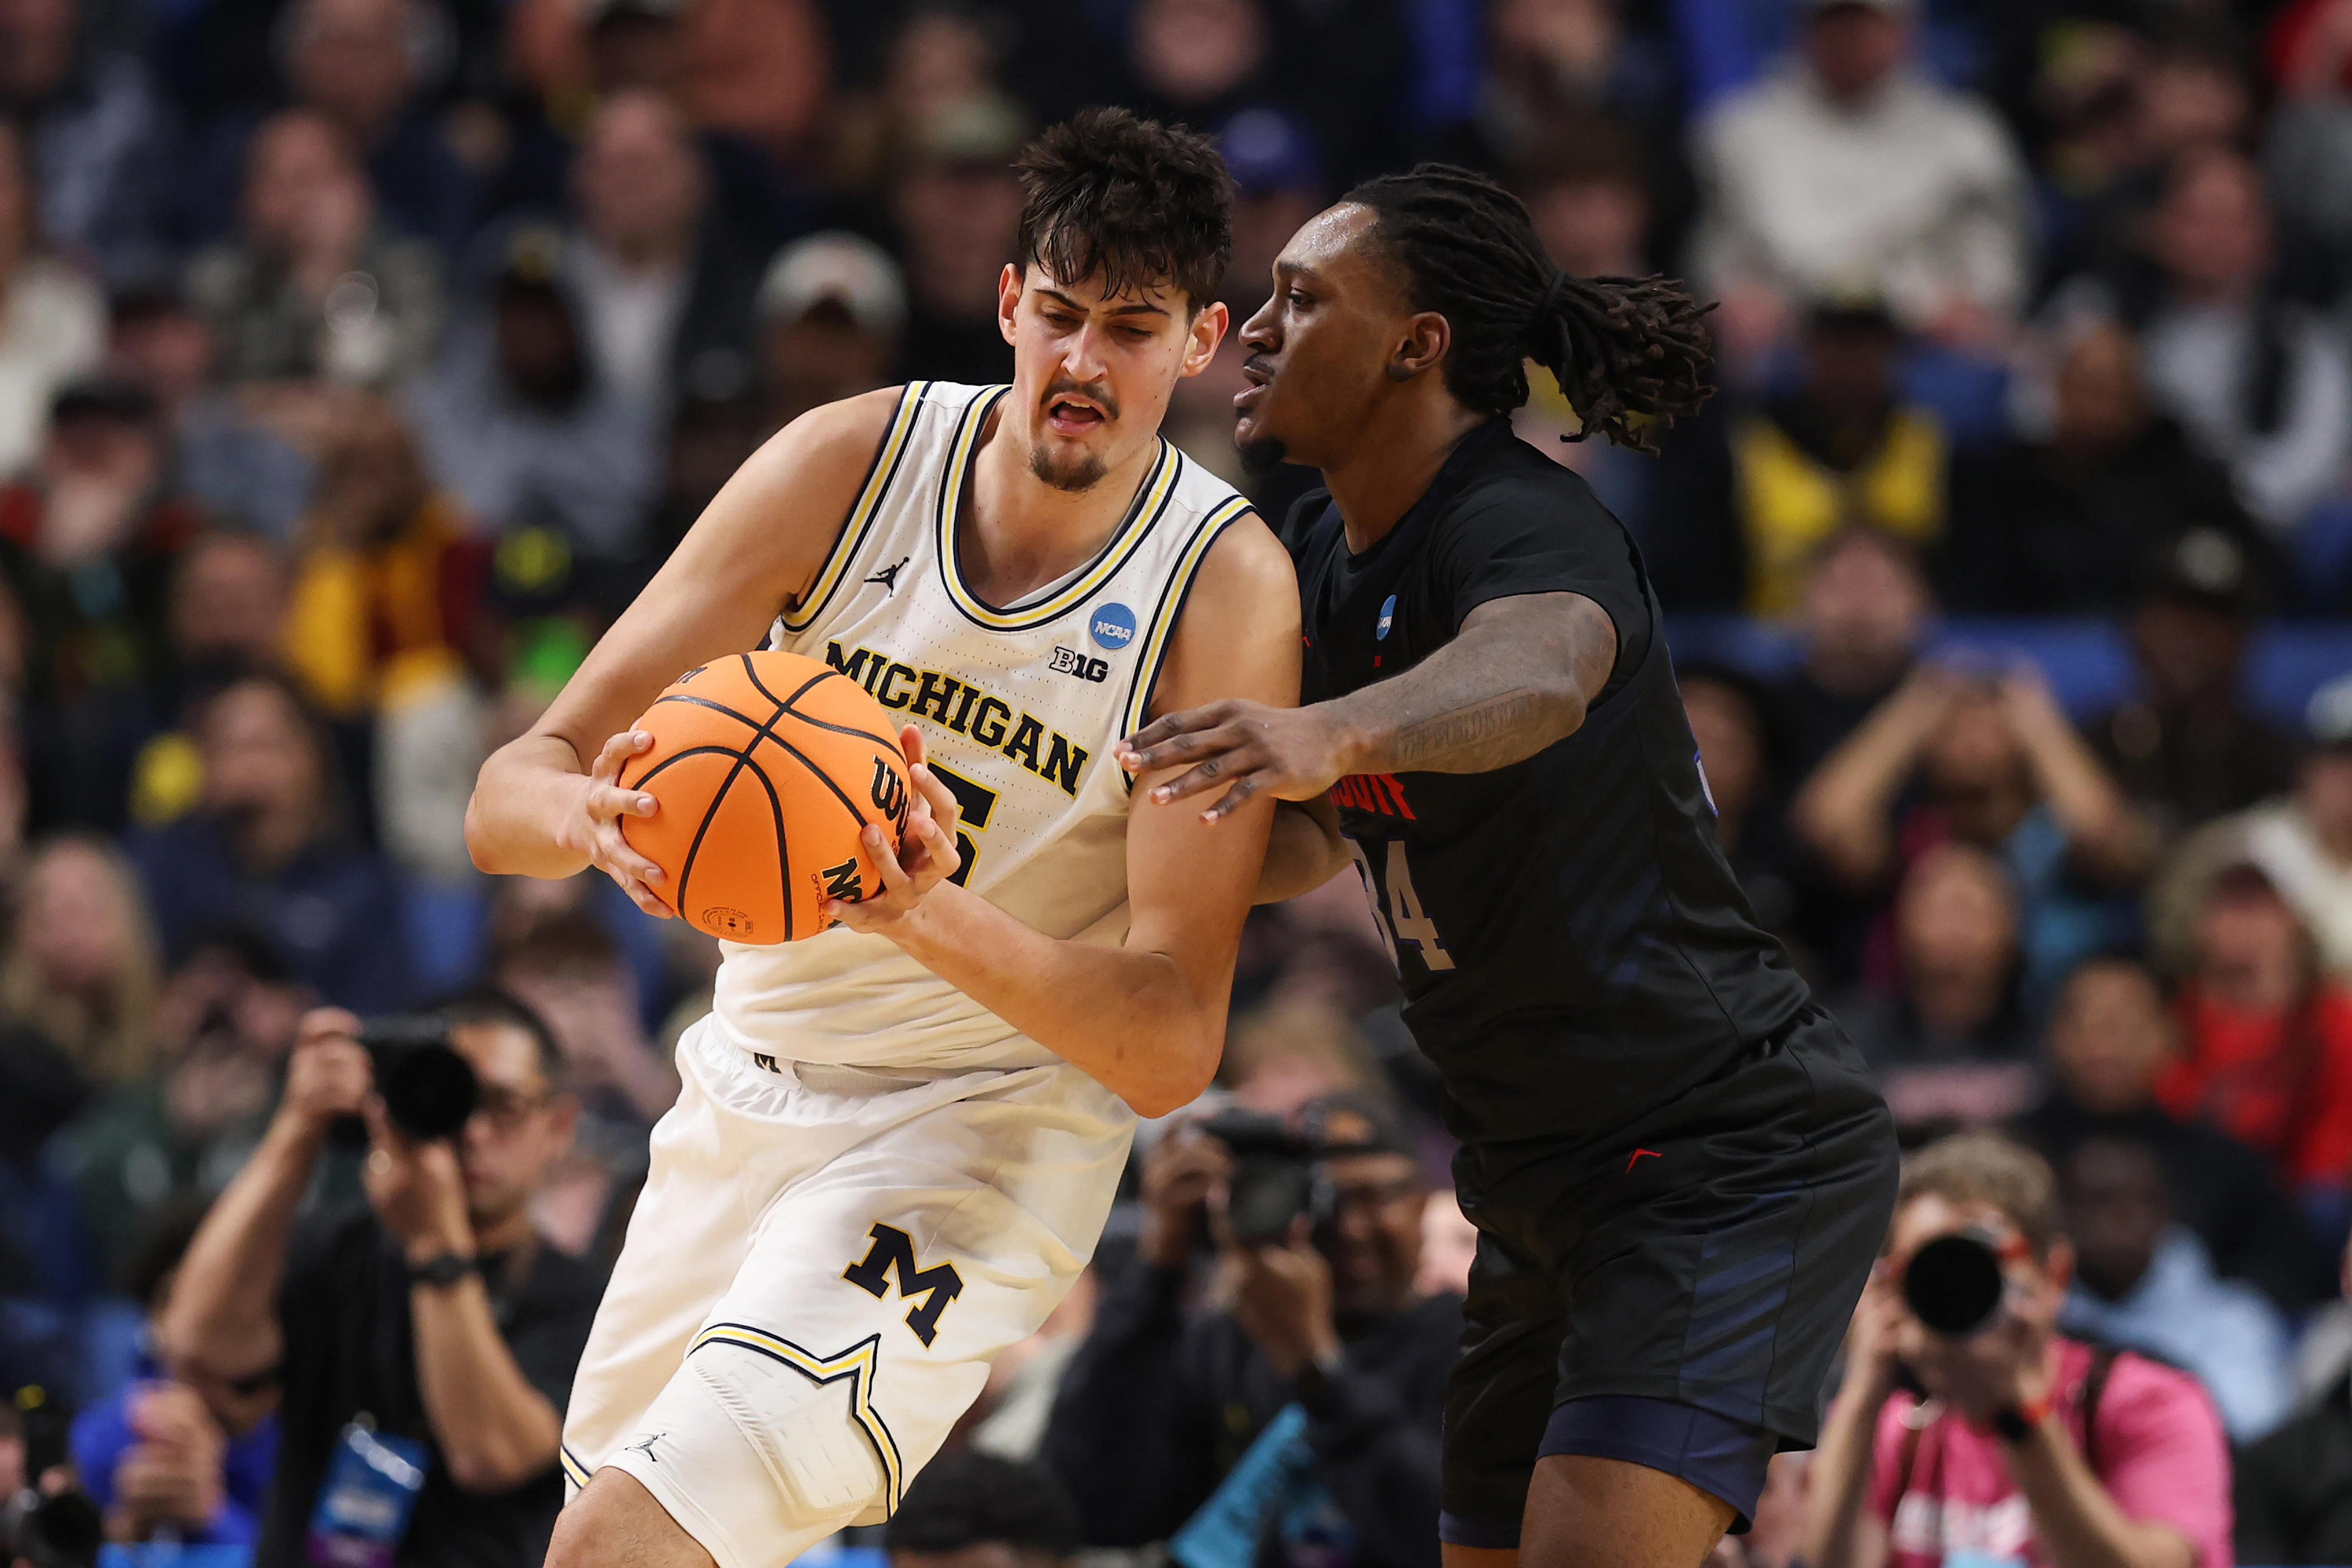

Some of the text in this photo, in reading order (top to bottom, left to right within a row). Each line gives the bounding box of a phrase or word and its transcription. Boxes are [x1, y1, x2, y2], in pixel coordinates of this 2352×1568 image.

[1094, 621, 1132, 641] NCAA
[825, 640, 1090, 800] MICHIGAN
[840, 1221, 965, 1353] M
